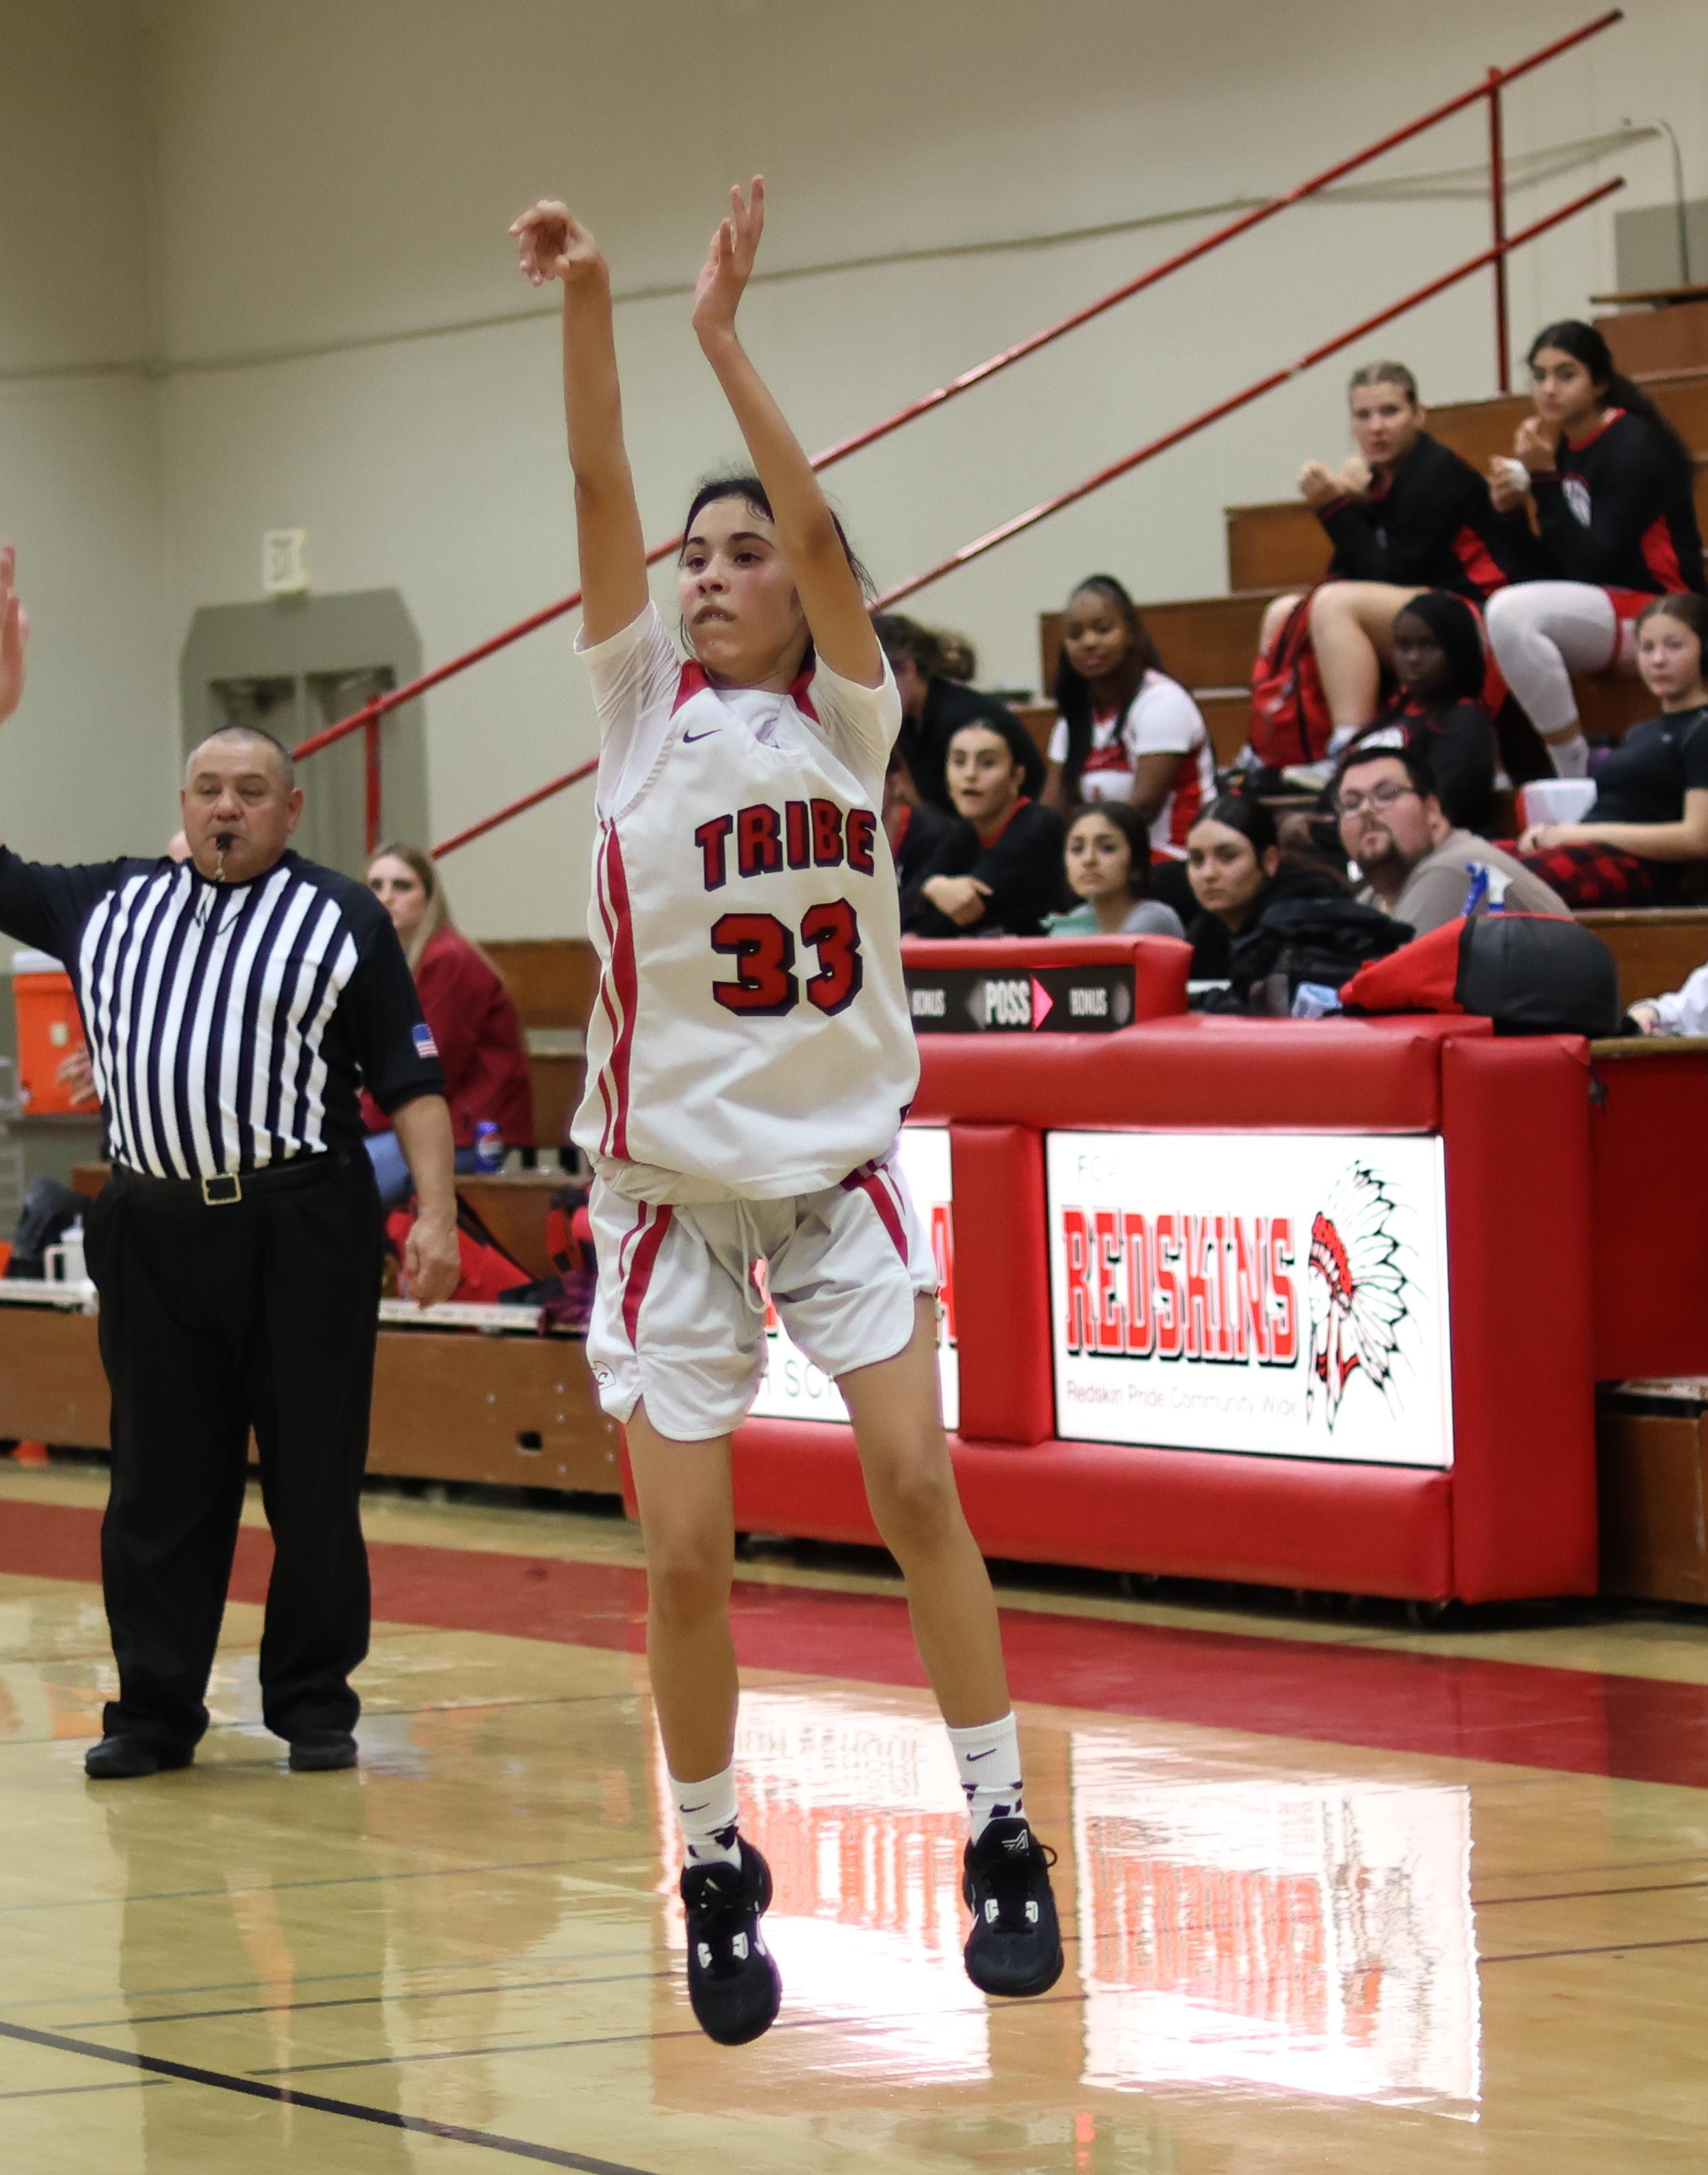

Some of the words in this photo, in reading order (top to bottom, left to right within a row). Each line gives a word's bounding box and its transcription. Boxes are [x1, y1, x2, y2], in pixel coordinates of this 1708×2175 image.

[694, 798, 877, 892] TRIBE
[710, 897, 864, 1017] 33
[911, 987, 946, 1018] BONUS
[984, 979, 1031, 1025] POSS
[1069, 986, 1108, 1017] BONUS
[1062, 1205, 1300, 1369] REDSKINS
[1066, 1380, 1123, 1405] Redskin
[1128, 1384, 1166, 1408] Pride
[1171, 1386, 1255, 1419] Community
[1261, 1394, 1299, 1417] Wide
